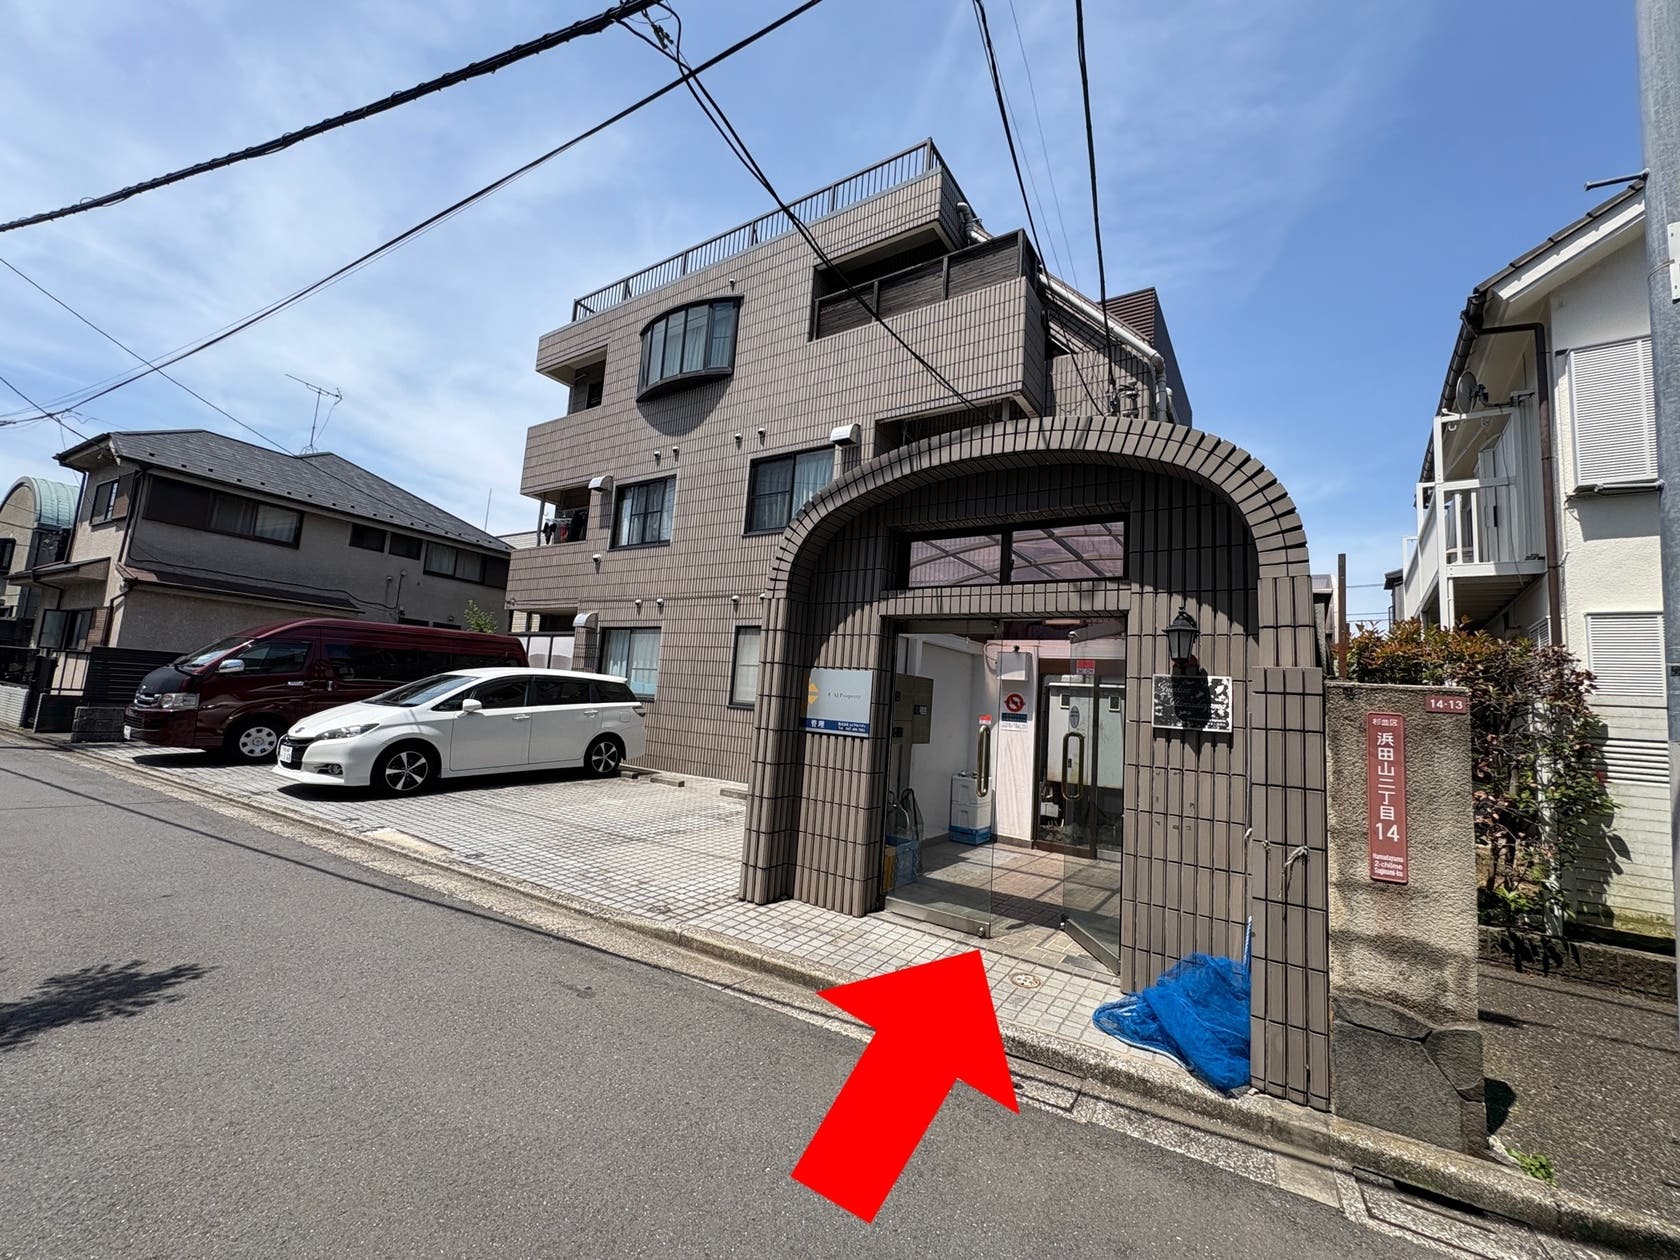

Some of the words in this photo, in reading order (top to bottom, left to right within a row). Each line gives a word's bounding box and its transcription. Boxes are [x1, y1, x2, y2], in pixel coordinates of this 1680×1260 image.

[1430, 699, 1463, 710] 14-13
[1377, 732, 1396, 820] 浜田山二丁目
[1375, 822, 1400, 842] 14
